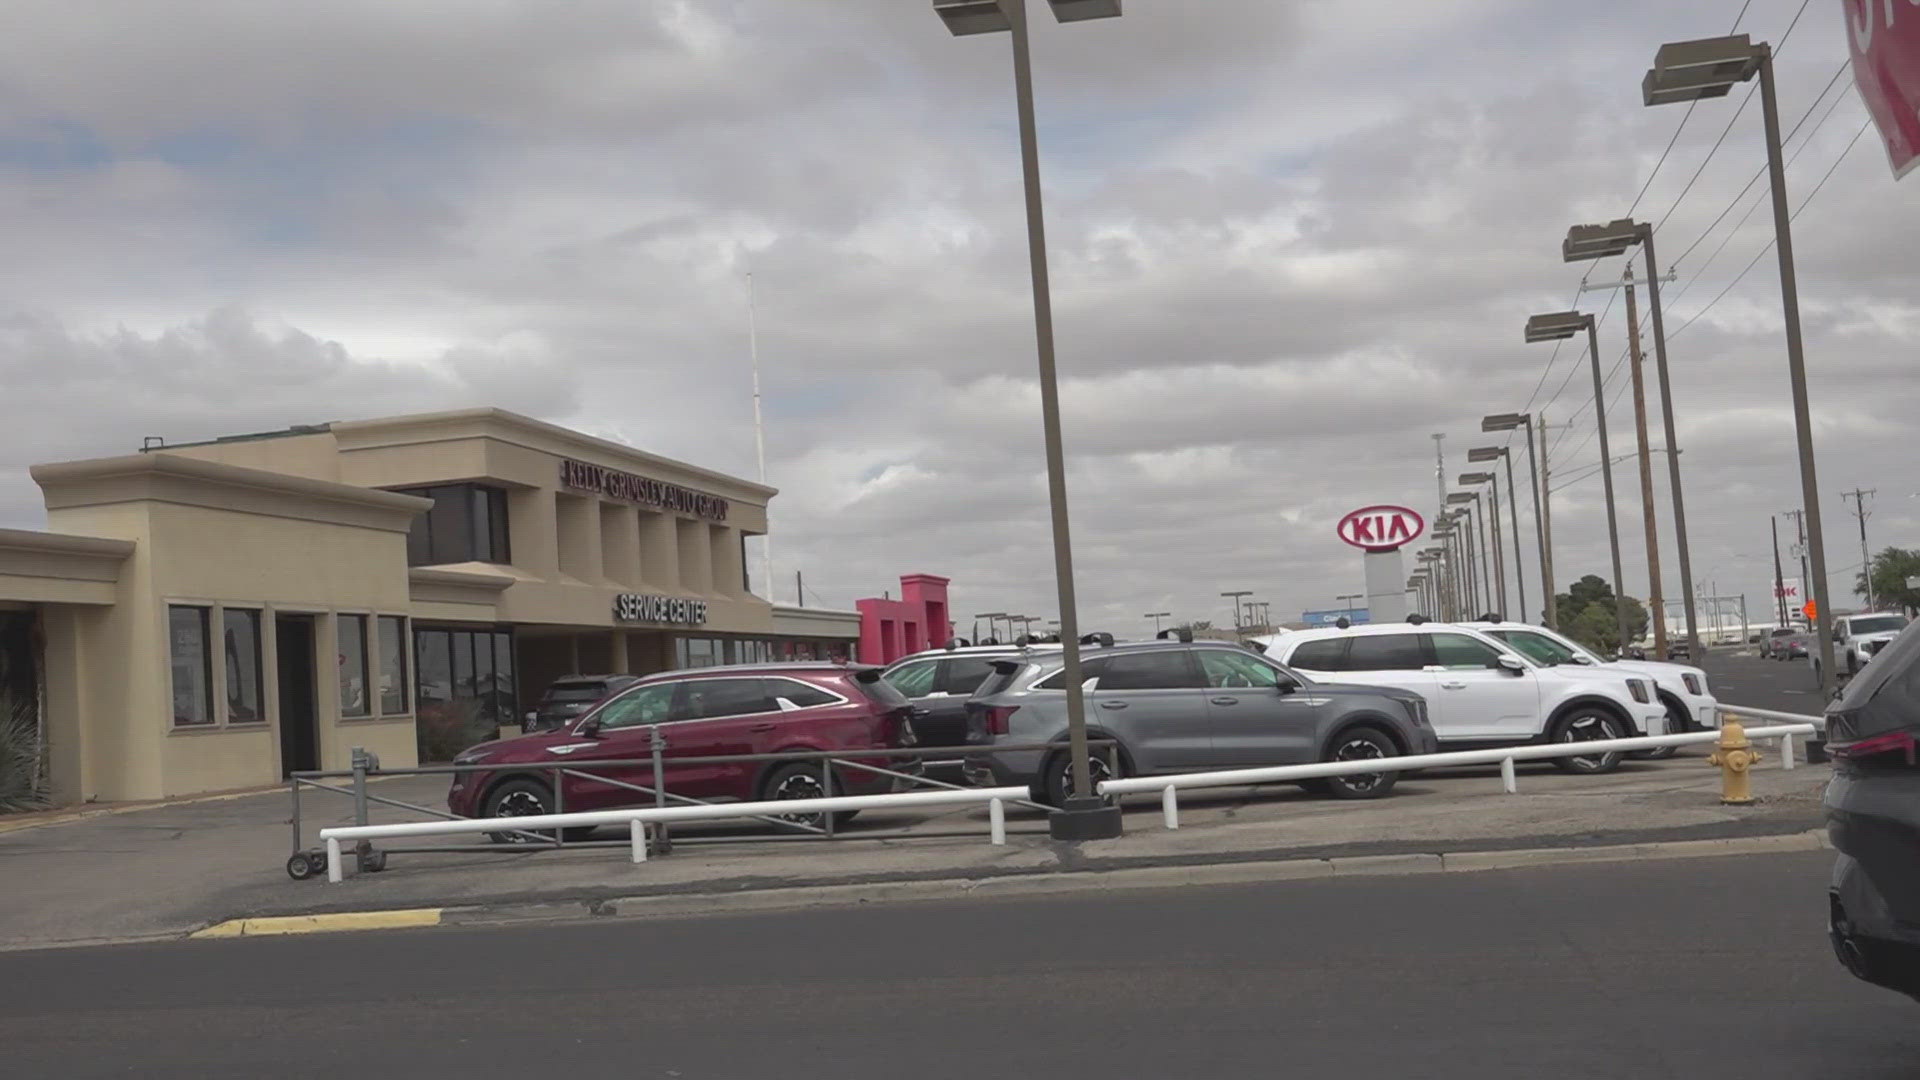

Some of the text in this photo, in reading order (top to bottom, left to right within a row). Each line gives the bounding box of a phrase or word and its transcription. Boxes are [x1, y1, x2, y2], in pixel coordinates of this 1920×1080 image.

[567, 461, 728, 521] KELLY GRIMSLEY AUTO GROUP
[1350, 513, 1410, 541] KIA
[619, 594, 707, 624] SERVICE CENTER
